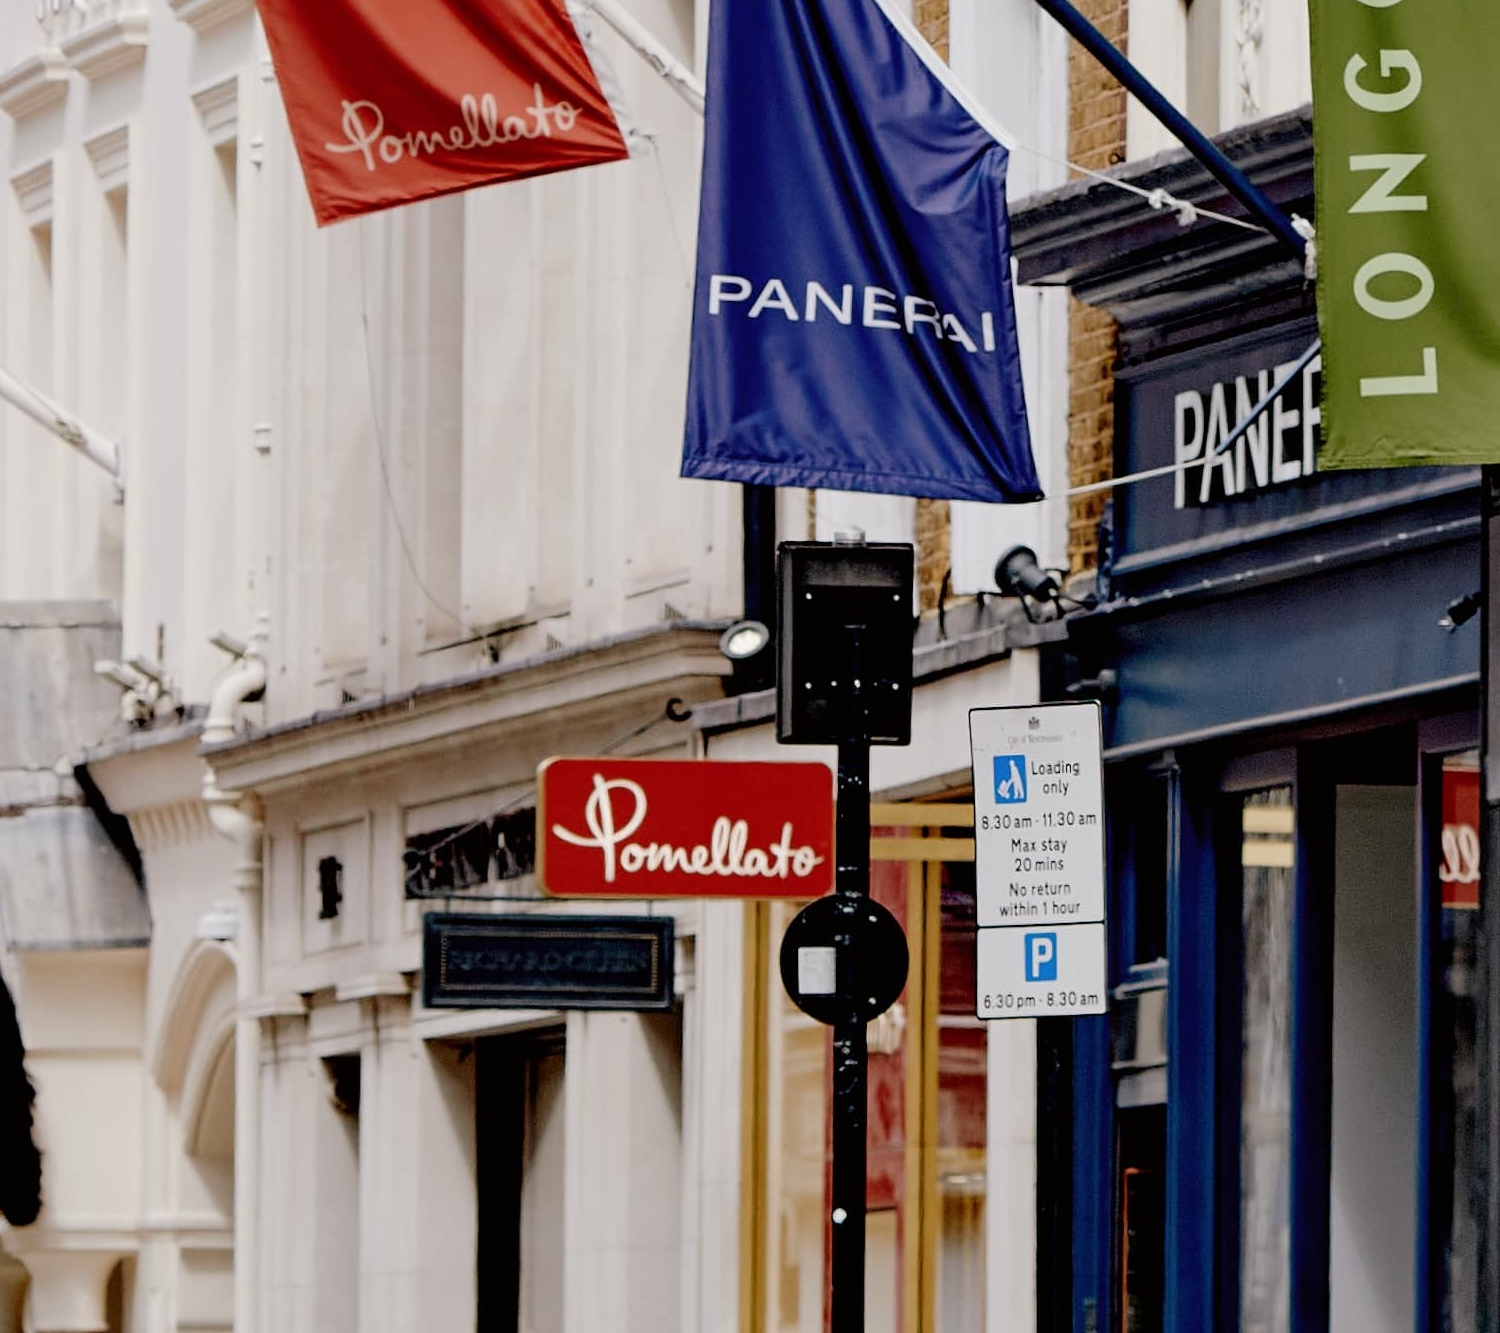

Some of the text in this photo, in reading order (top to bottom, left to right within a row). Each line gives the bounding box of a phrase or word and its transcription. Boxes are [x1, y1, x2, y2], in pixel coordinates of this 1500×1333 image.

[325, 83, 582, 173] Pomellato
[709, 274, 995, 353] PANERAI
[1031, 760, 1081, 776] Loading
[1043, 780, 1069, 797] only
[553, 774, 825, 882] Pomellato
[982, 813, 1011, 830] 8.30
[1014, 816, 1032, 829] am
[1043, 811, 1075, 827] 11.30
[1078, 813, 1097, 826] am
[1011, 837, 1068, 853] Max stay
[1014, 856, 1064, 872] 20 mins
[1009, 881, 1072, 897] No return
[999, 901, 1039, 917] within
[1052, 900, 1081, 915] hour
[1032, 937, 1053, 978] P
[984, 993, 1014, 1010] 6.30
[1017, 995, 1037, 1010] pm
[1047, 991, 1077, 1008] 8.30
[1080, 993, 1099, 1007] am
